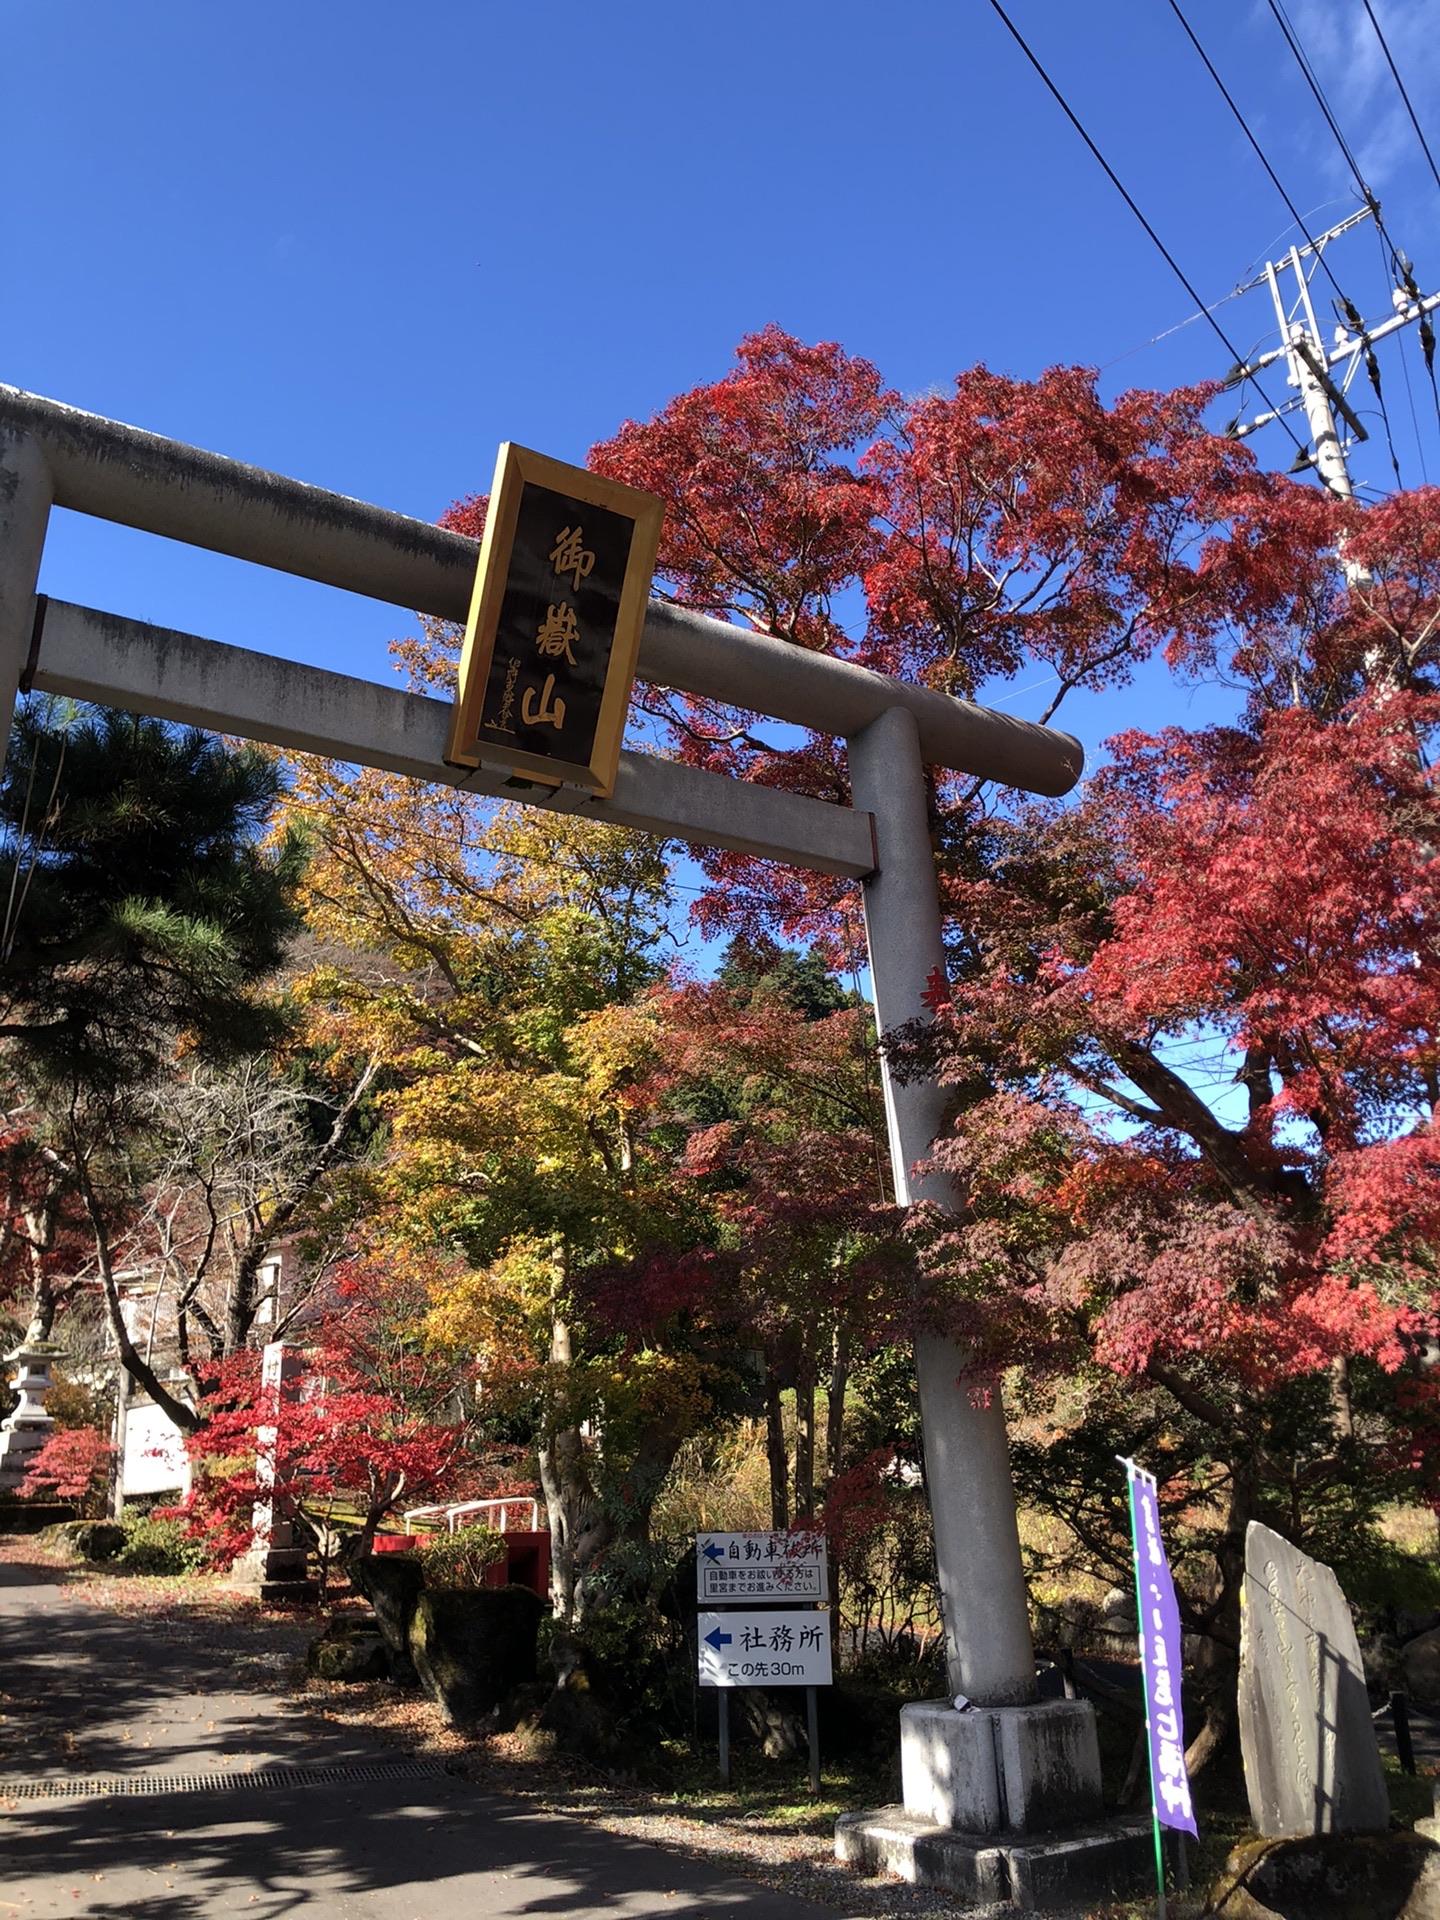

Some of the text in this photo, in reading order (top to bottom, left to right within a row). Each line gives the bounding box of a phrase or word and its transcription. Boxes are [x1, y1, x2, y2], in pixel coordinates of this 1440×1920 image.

[521, 525, 596, 730] 御嶽山
[739, 1624, 824, 1653] 社務所
[728, 1661, 805, 1677] この先30m
